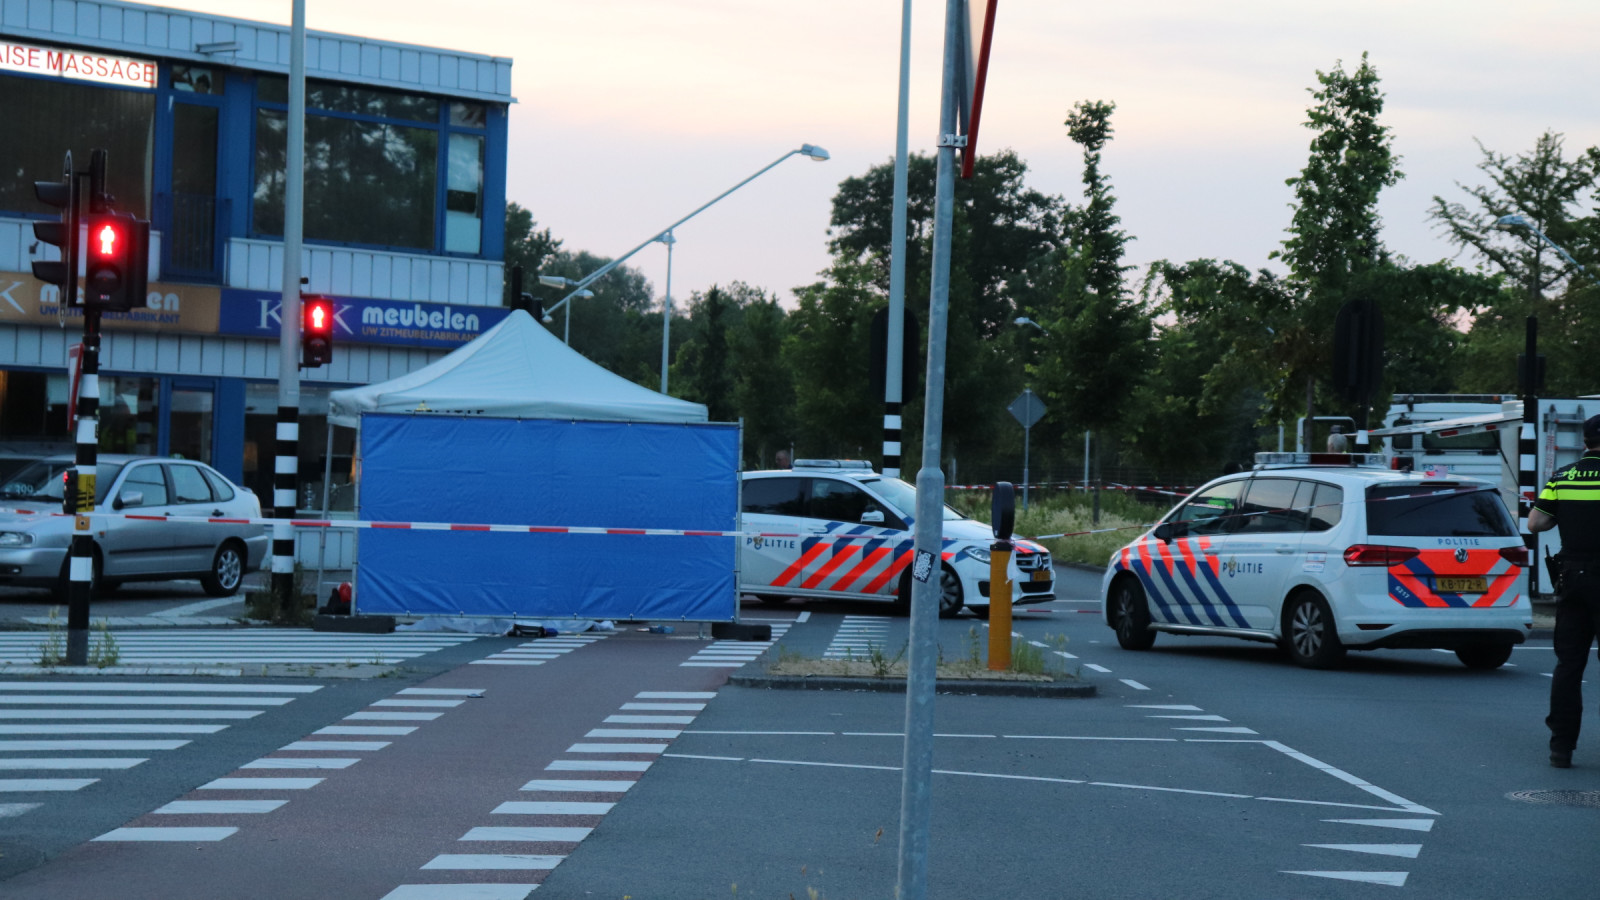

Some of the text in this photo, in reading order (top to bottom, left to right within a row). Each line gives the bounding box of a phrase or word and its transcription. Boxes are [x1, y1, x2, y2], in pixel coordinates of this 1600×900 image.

[0, 44, 155, 84] ISE MASSAGE
[361, 303, 480, 331] meubelen
[361, 326, 377, 336] UW
[746, 537, 795, 550] POLITIE
[1437, 538, 1480, 546] POLITIE
[1222, 562, 1263, 578] POLITIE
